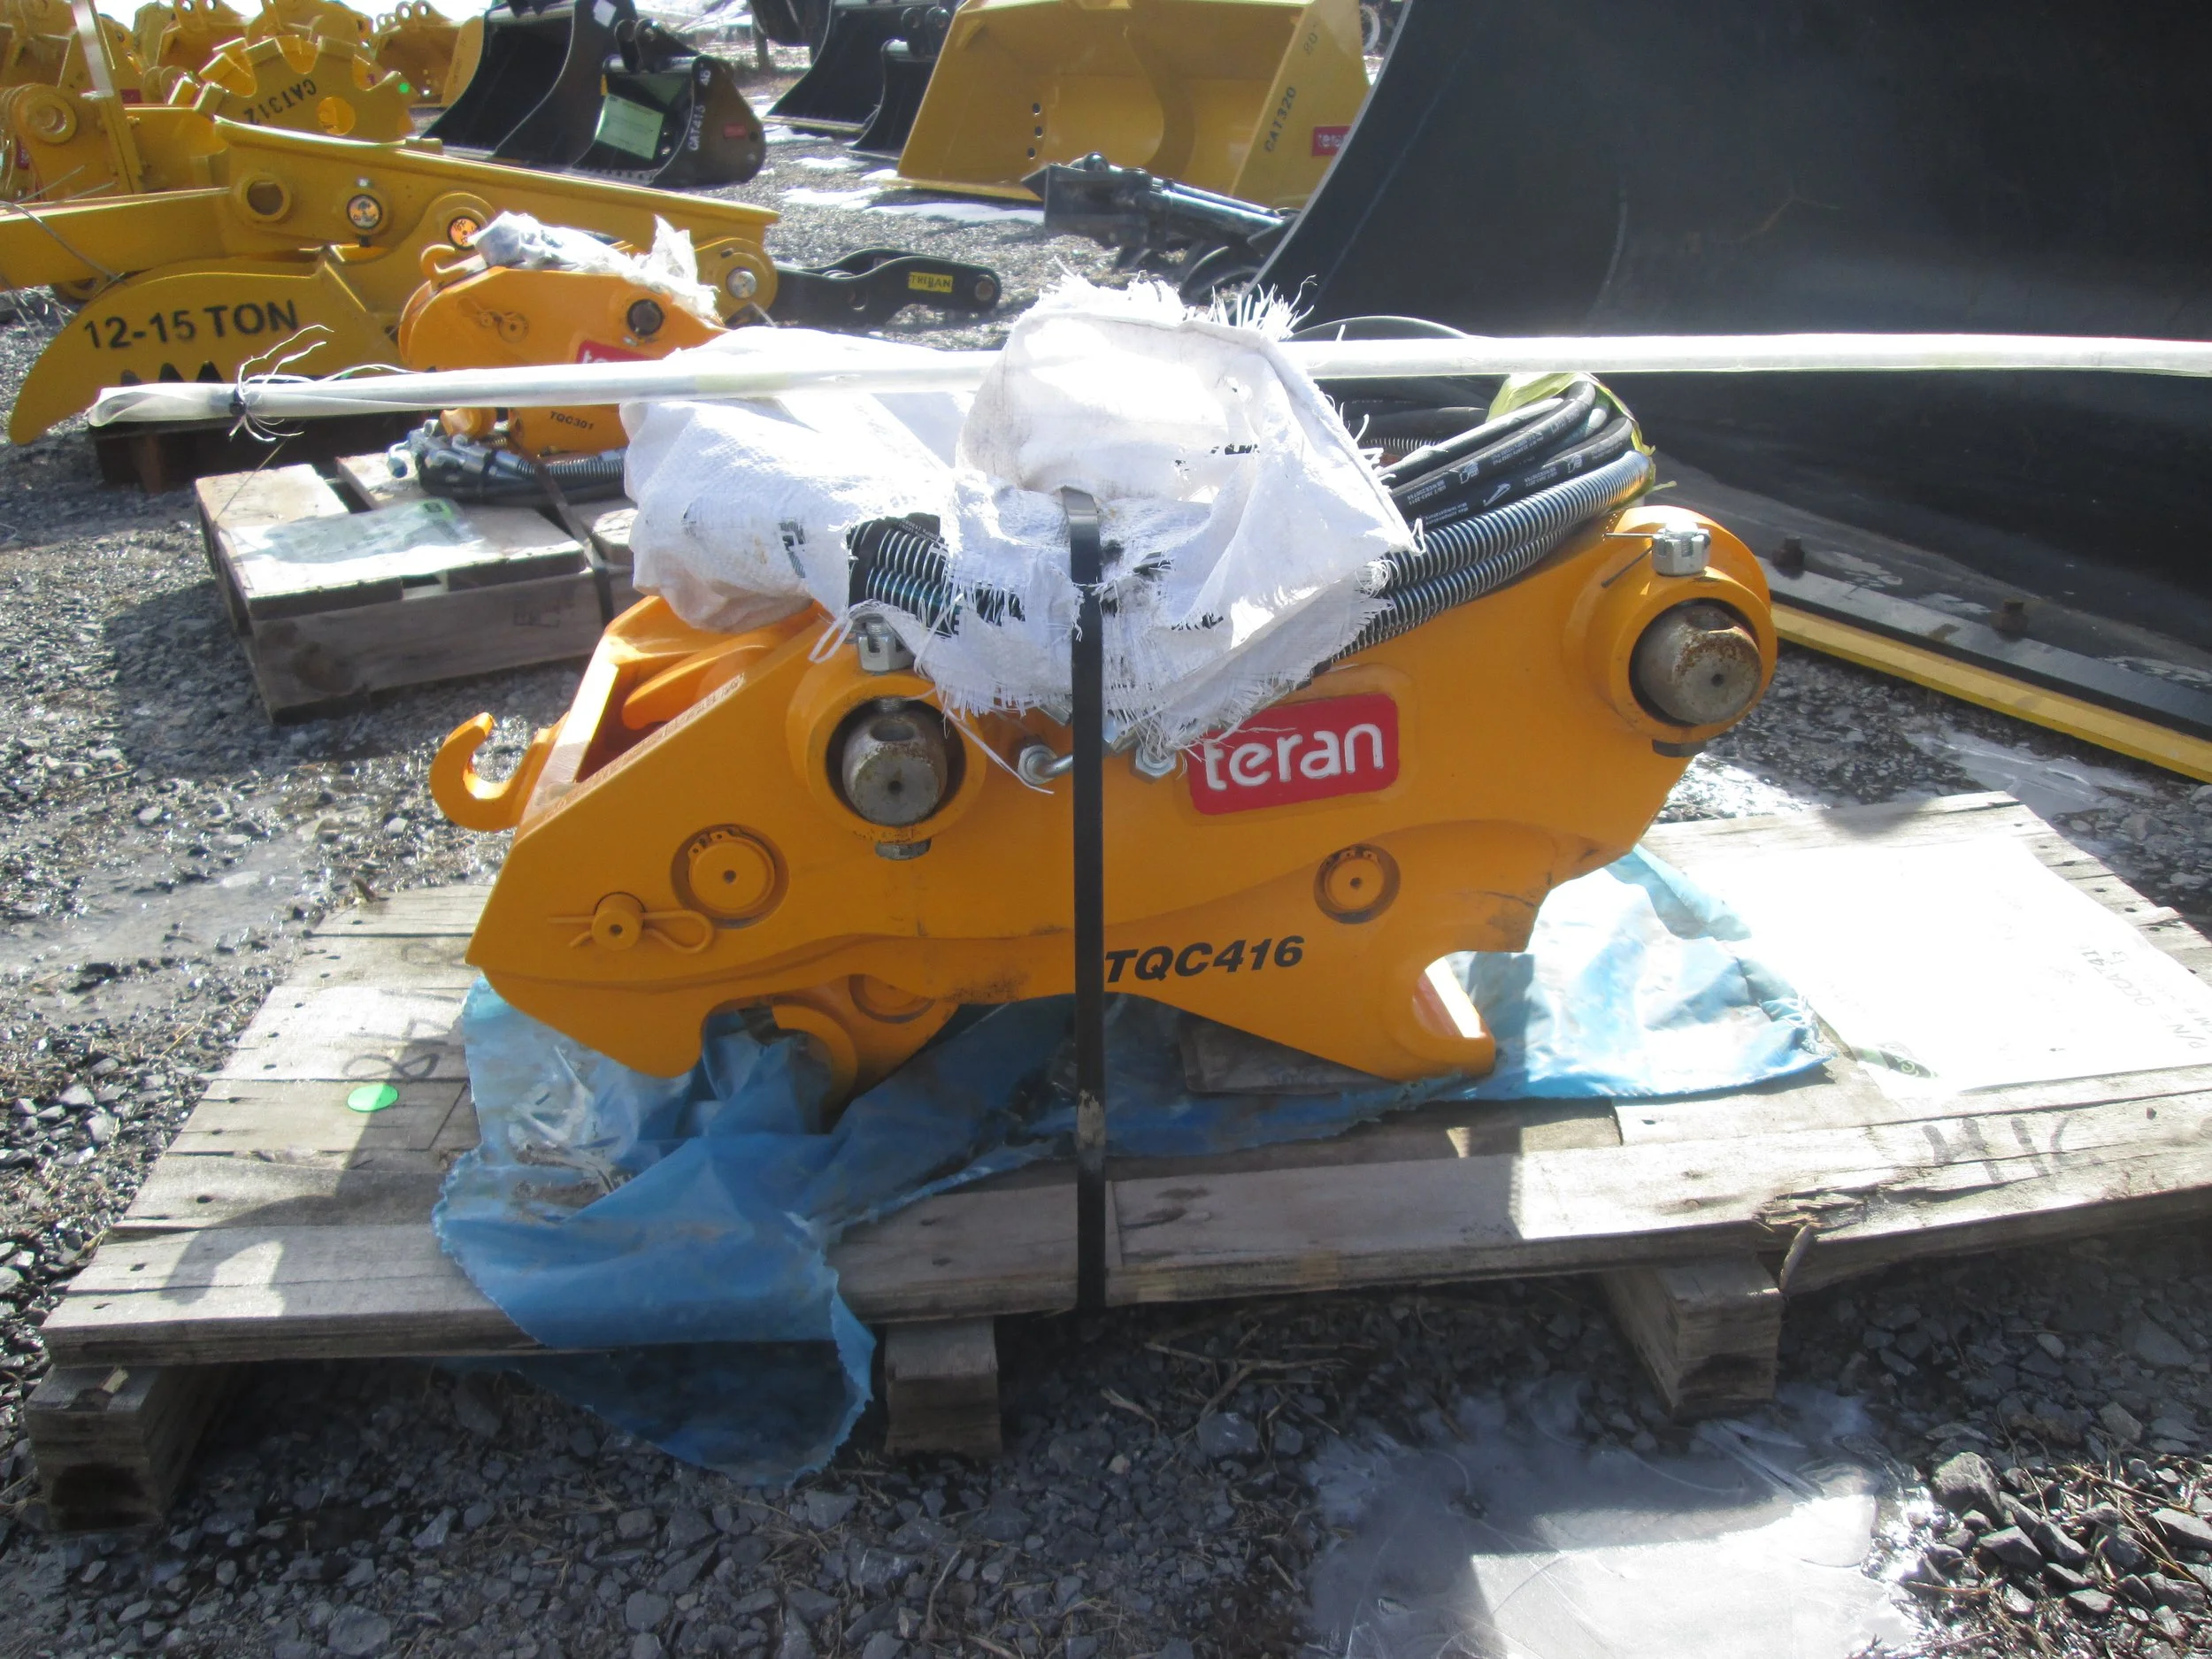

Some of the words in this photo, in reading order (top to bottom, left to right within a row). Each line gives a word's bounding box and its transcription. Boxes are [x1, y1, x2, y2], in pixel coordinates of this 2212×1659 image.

[242, 78, 317, 126] CAT312
[1265, 87, 1297, 153] CAT320
[84, 310, 196, 349] 12-15
[204, 299, 299, 338] TON
[549, 411, 594, 430] TQC301
[1202, 723, 1385, 791] teran
[1105, 935, 1304, 983] TQC416
